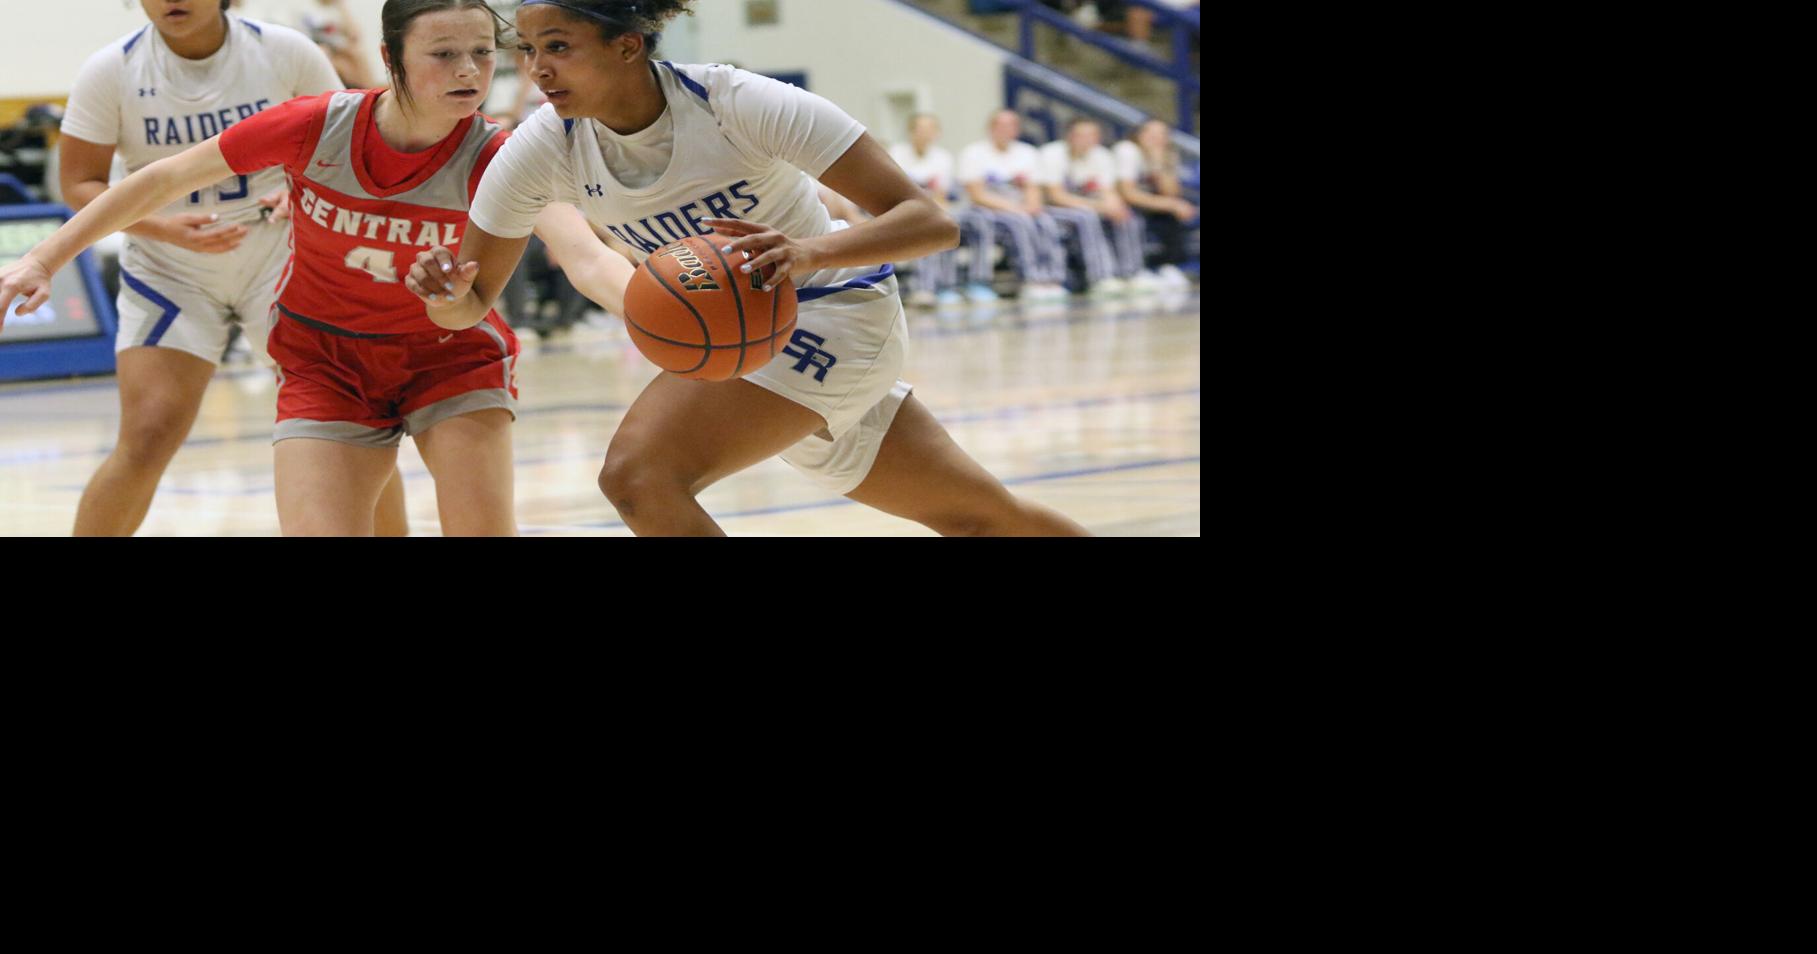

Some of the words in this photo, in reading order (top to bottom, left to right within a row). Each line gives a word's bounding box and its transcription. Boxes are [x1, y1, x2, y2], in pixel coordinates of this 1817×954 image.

[300, 187, 460, 247] CENTRAL
[606, 179, 760, 254] RAIDERS
[344, 245, 399, 283] 4
[781, 328, 837, 383] SR
